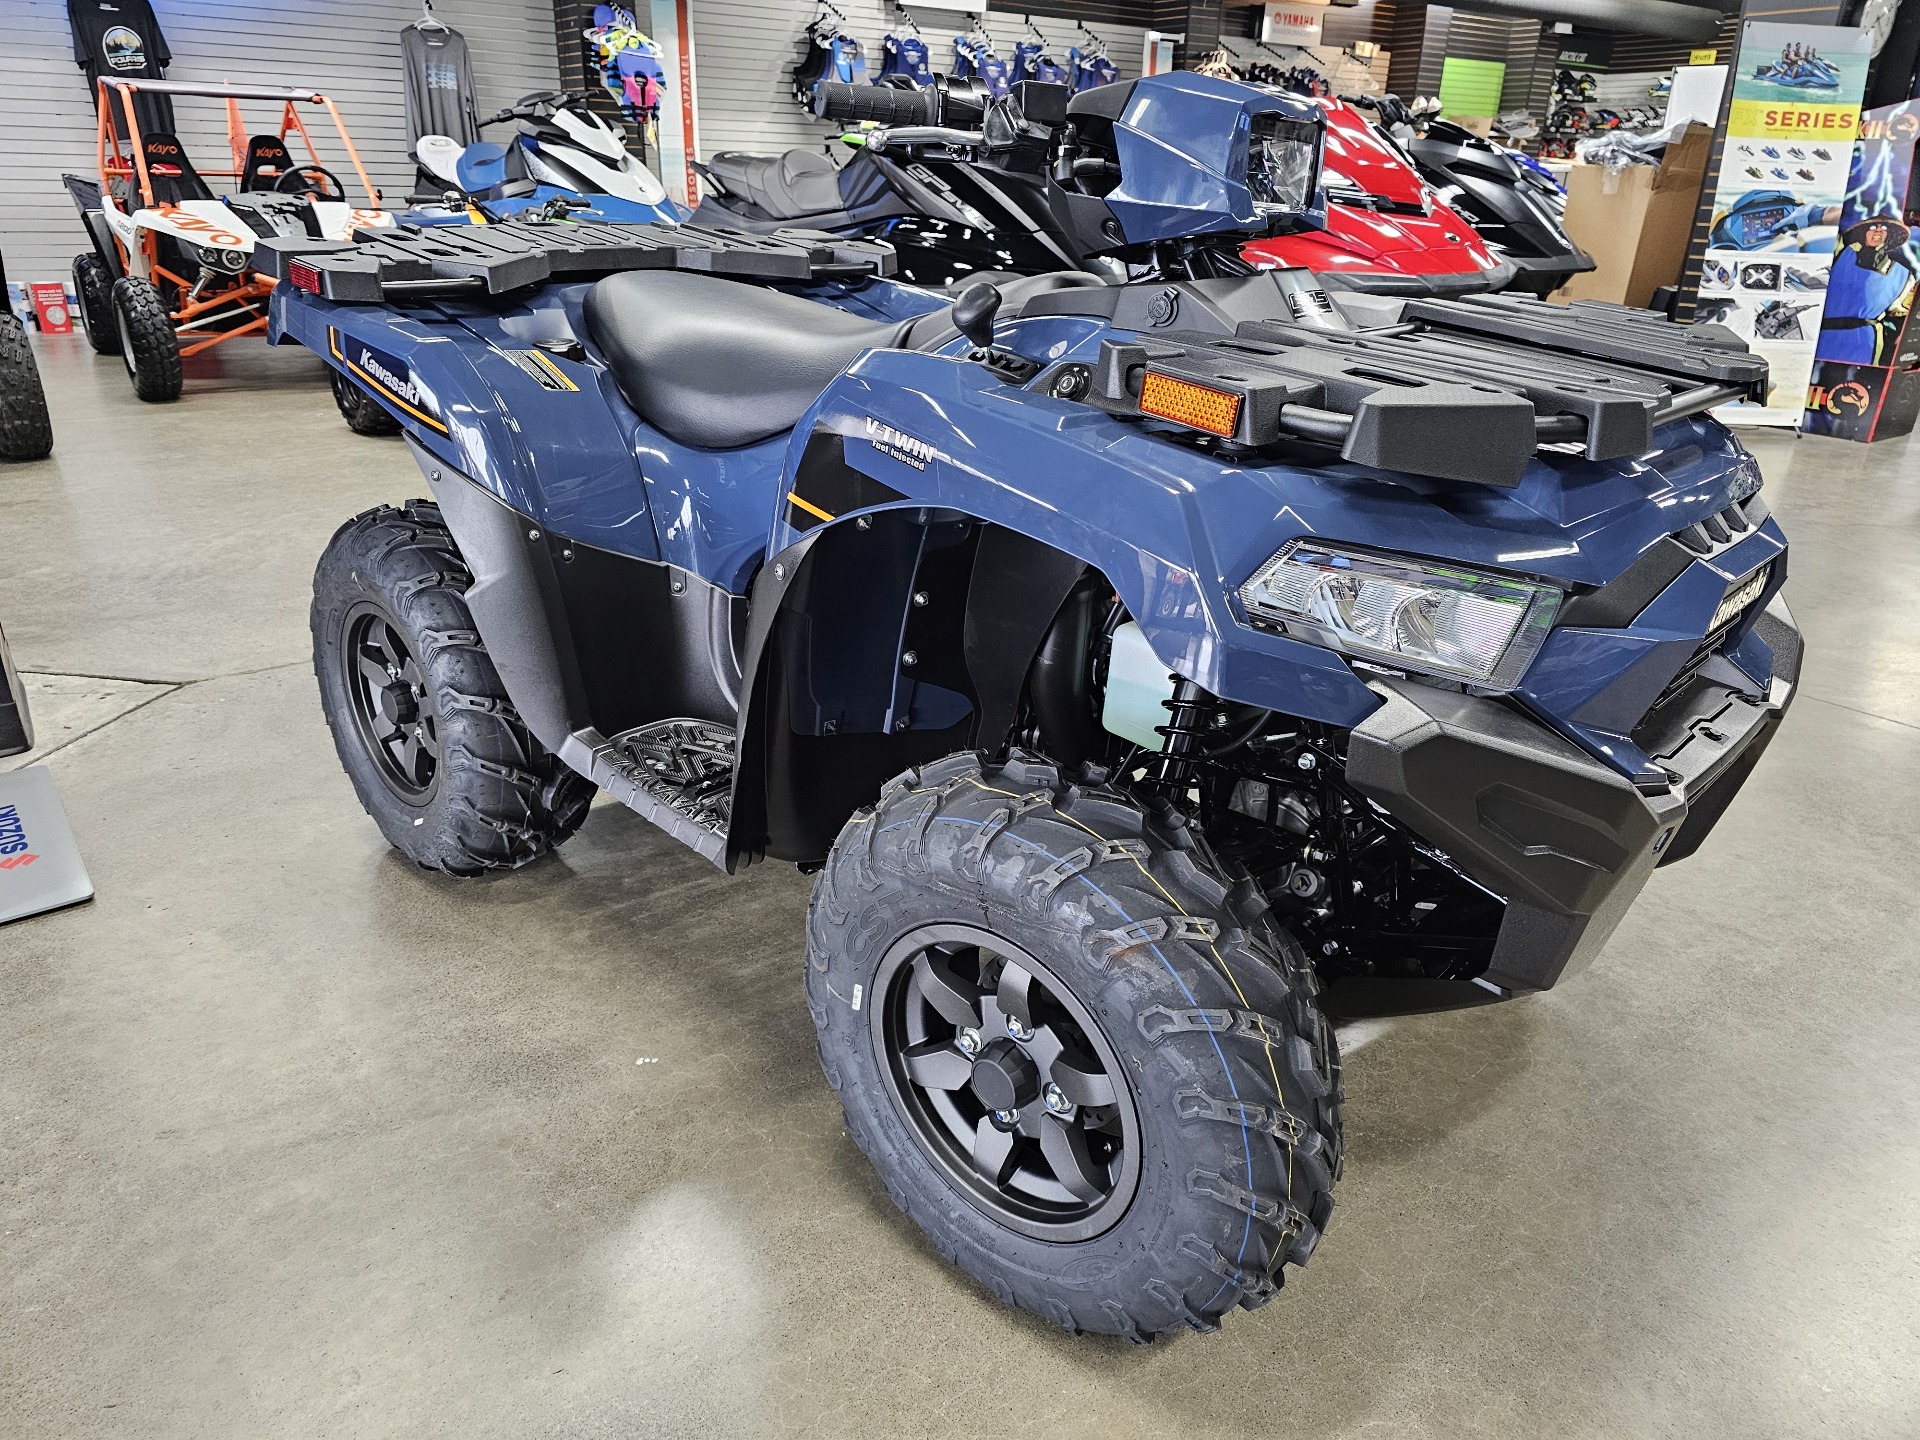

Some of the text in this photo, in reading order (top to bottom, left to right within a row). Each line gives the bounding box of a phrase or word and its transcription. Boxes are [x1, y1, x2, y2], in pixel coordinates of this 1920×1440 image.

[1283, 13, 1314, 27] YAMAHA
[110, 55, 146, 65] POLARIS
[681, 54, 692, 110] APPAREL
[1764, 110, 1854, 129] SERIES
[147, 142, 178, 155] KAYO
[256, 146, 283, 158] KAYO
[906, 163, 952, 192] GP
[150, 205, 243, 245] KAYO
[360, 348, 420, 406] Kawasaki
[866, 416, 935, 463] V-TWIN
[1708, 566, 1771, 633] awasaki
[0, 804, 29, 855] SUZUKI
[845, 888, 907, 965] CST
